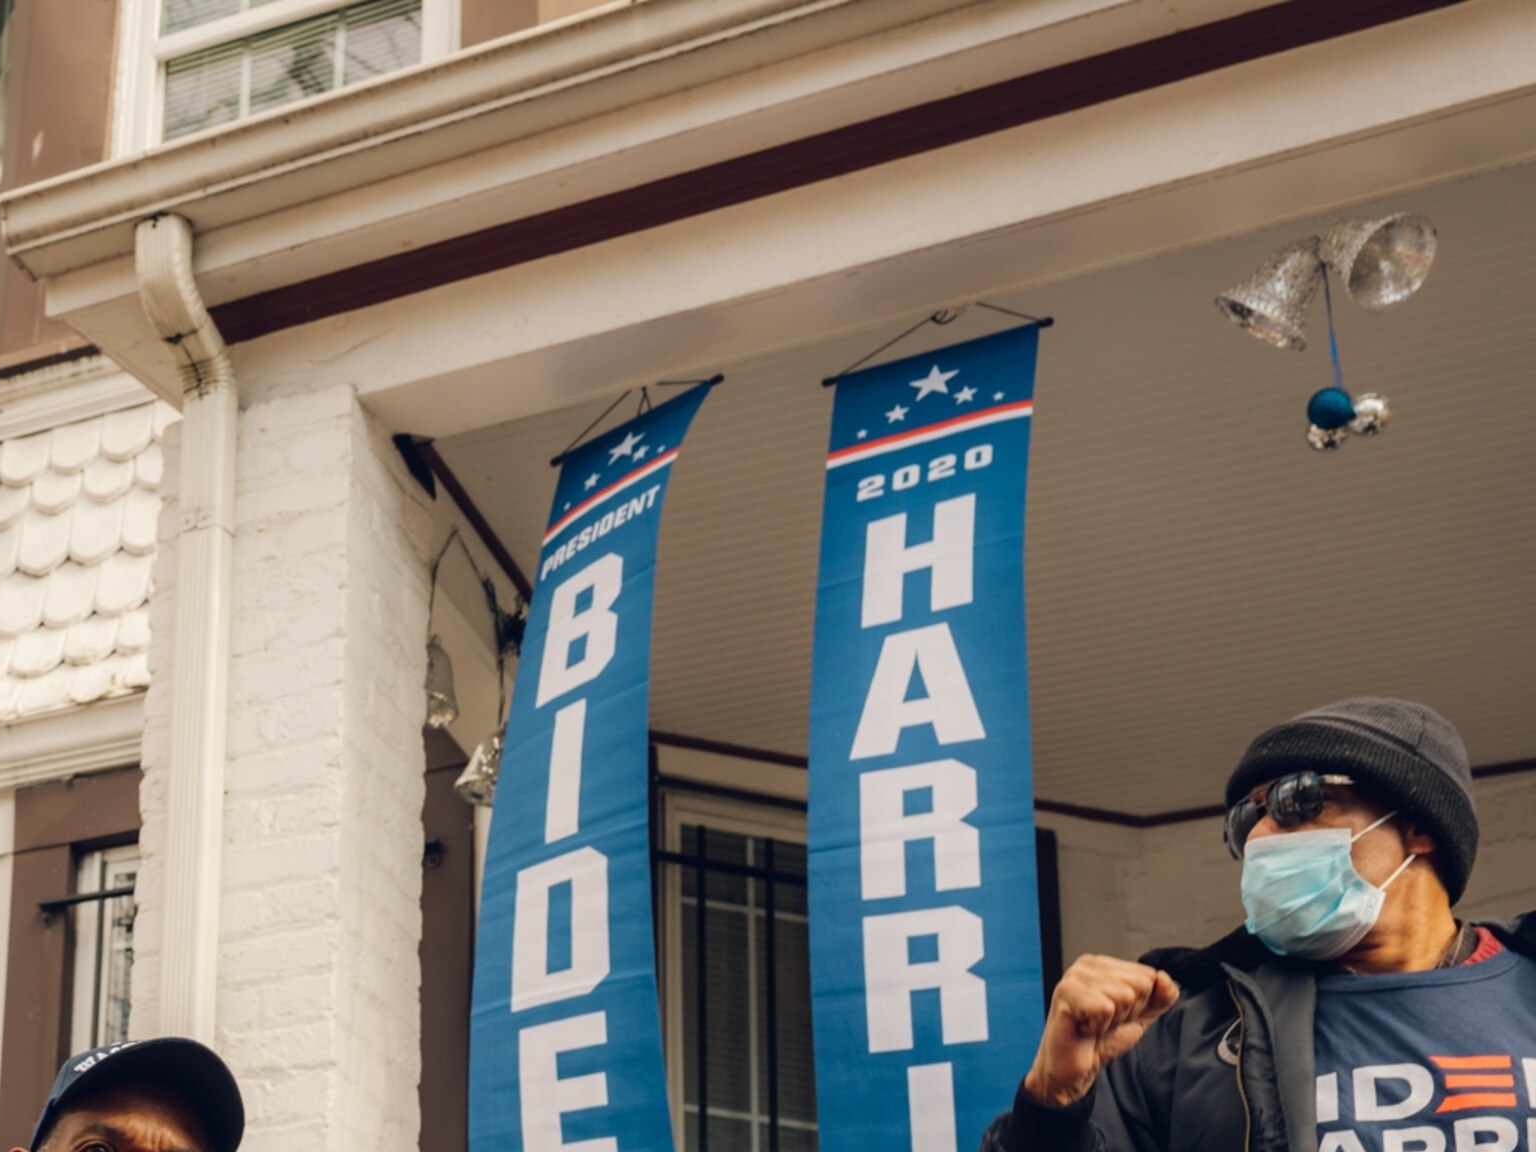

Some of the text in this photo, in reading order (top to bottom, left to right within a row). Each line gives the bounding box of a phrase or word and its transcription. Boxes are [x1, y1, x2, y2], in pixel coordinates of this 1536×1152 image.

[855, 443, 994, 503] 2020
[540, 484, 661, 582] PRESIDENT
[1316, 1055, 1536, 1123] IDE
